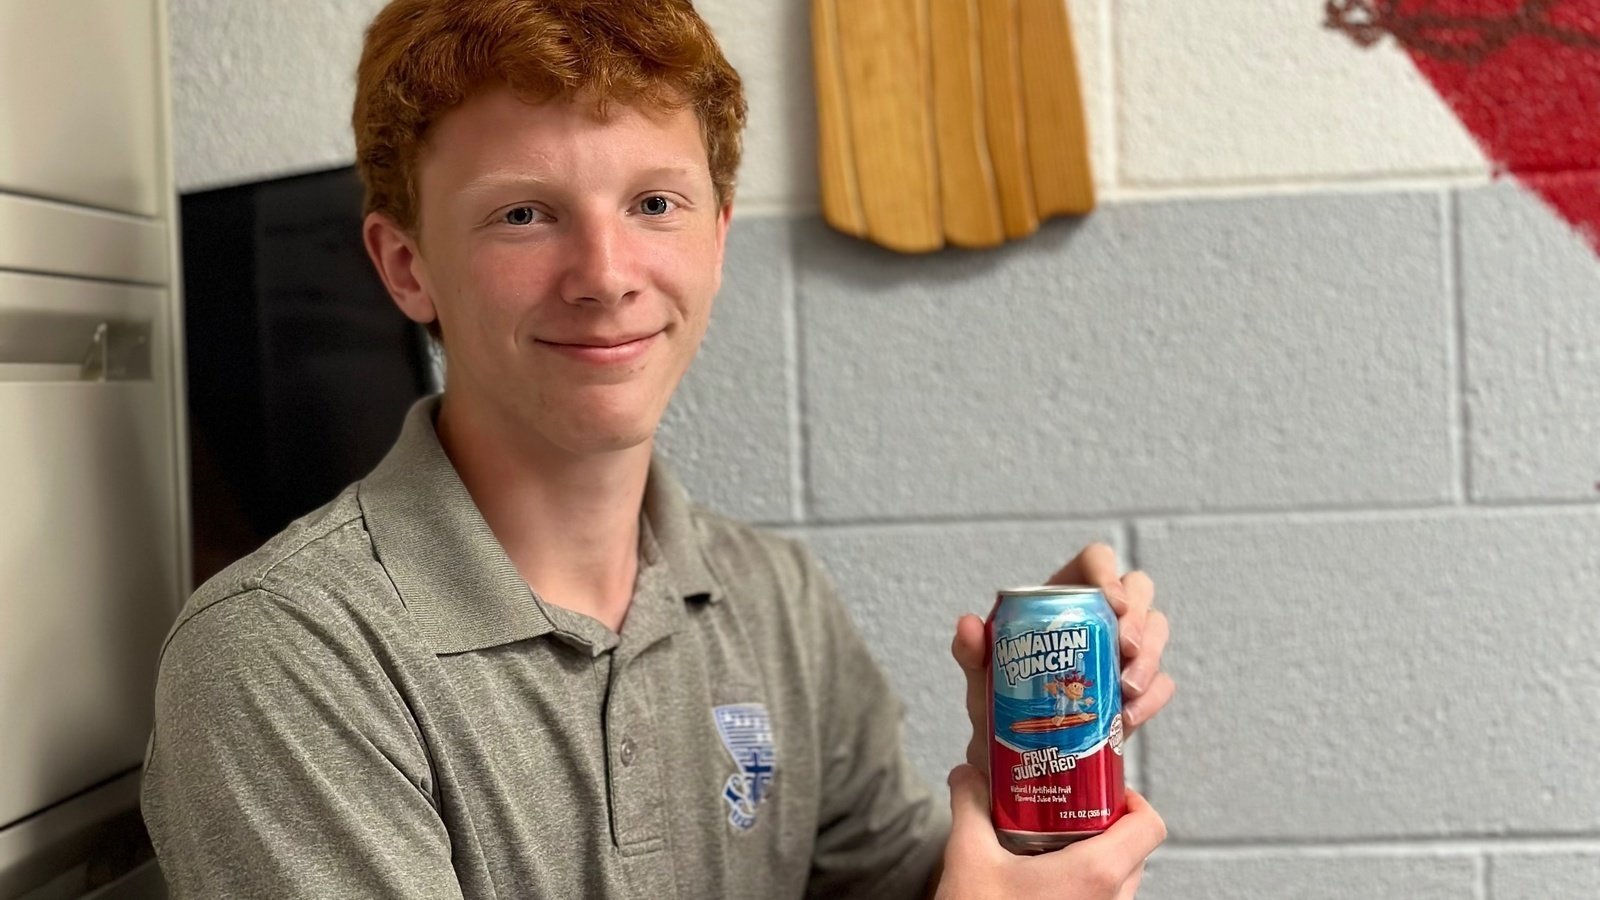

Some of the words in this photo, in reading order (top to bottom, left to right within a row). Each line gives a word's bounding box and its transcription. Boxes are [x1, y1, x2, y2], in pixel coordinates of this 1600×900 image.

[997, 628, 1088, 667] HAWAIIAN
[1005, 648, 1075, 685] PUNCH
[1022, 746, 1059, 766] FRUIT
[1013, 760, 1048, 781] JUICY
[1049, 756, 1077, 774] RED
[1036, 795, 1051, 803] Juice
[1051, 794, 1067, 803] Drink
[1057, 785, 1072, 794] Fruit
[1059, 811, 1068, 819] 12
[1068, 811, 1077, 819] FL
[1077, 810, 1087, 818] OZ
